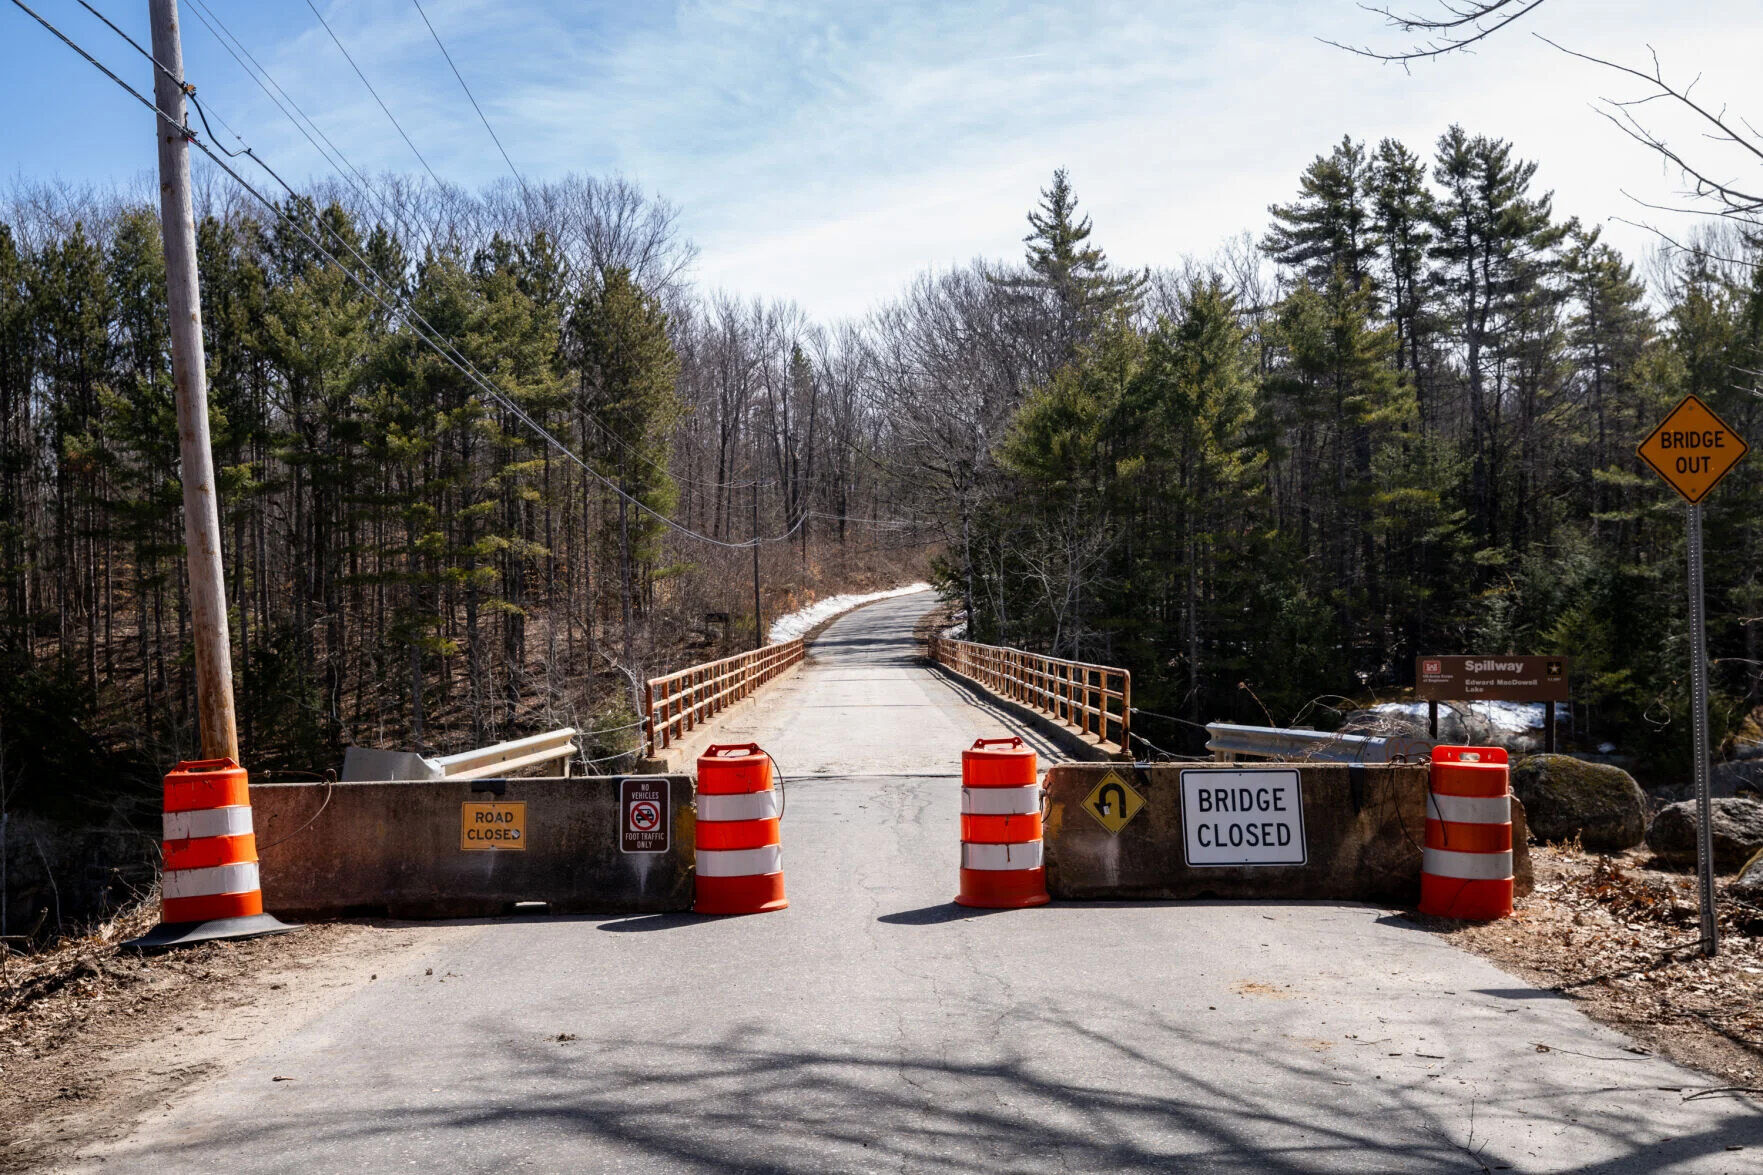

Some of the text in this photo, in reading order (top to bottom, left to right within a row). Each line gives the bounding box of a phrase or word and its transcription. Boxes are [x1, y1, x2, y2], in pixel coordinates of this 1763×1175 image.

[1661, 431, 1725, 449] BRIDGE
[1675, 456, 1711, 474] OUT
[1465, 660, 1524, 673] Spillway
[641, 784, 650, 792] NO
[631, 792, 660, 800] VEHICLES
[1198, 788, 1287, 813] BRIDGE
[475, 811, 514, 823] ROAD
[1197, 822, 1291, 847] CLOSED
[636, 841, 653, 849] ONLY
